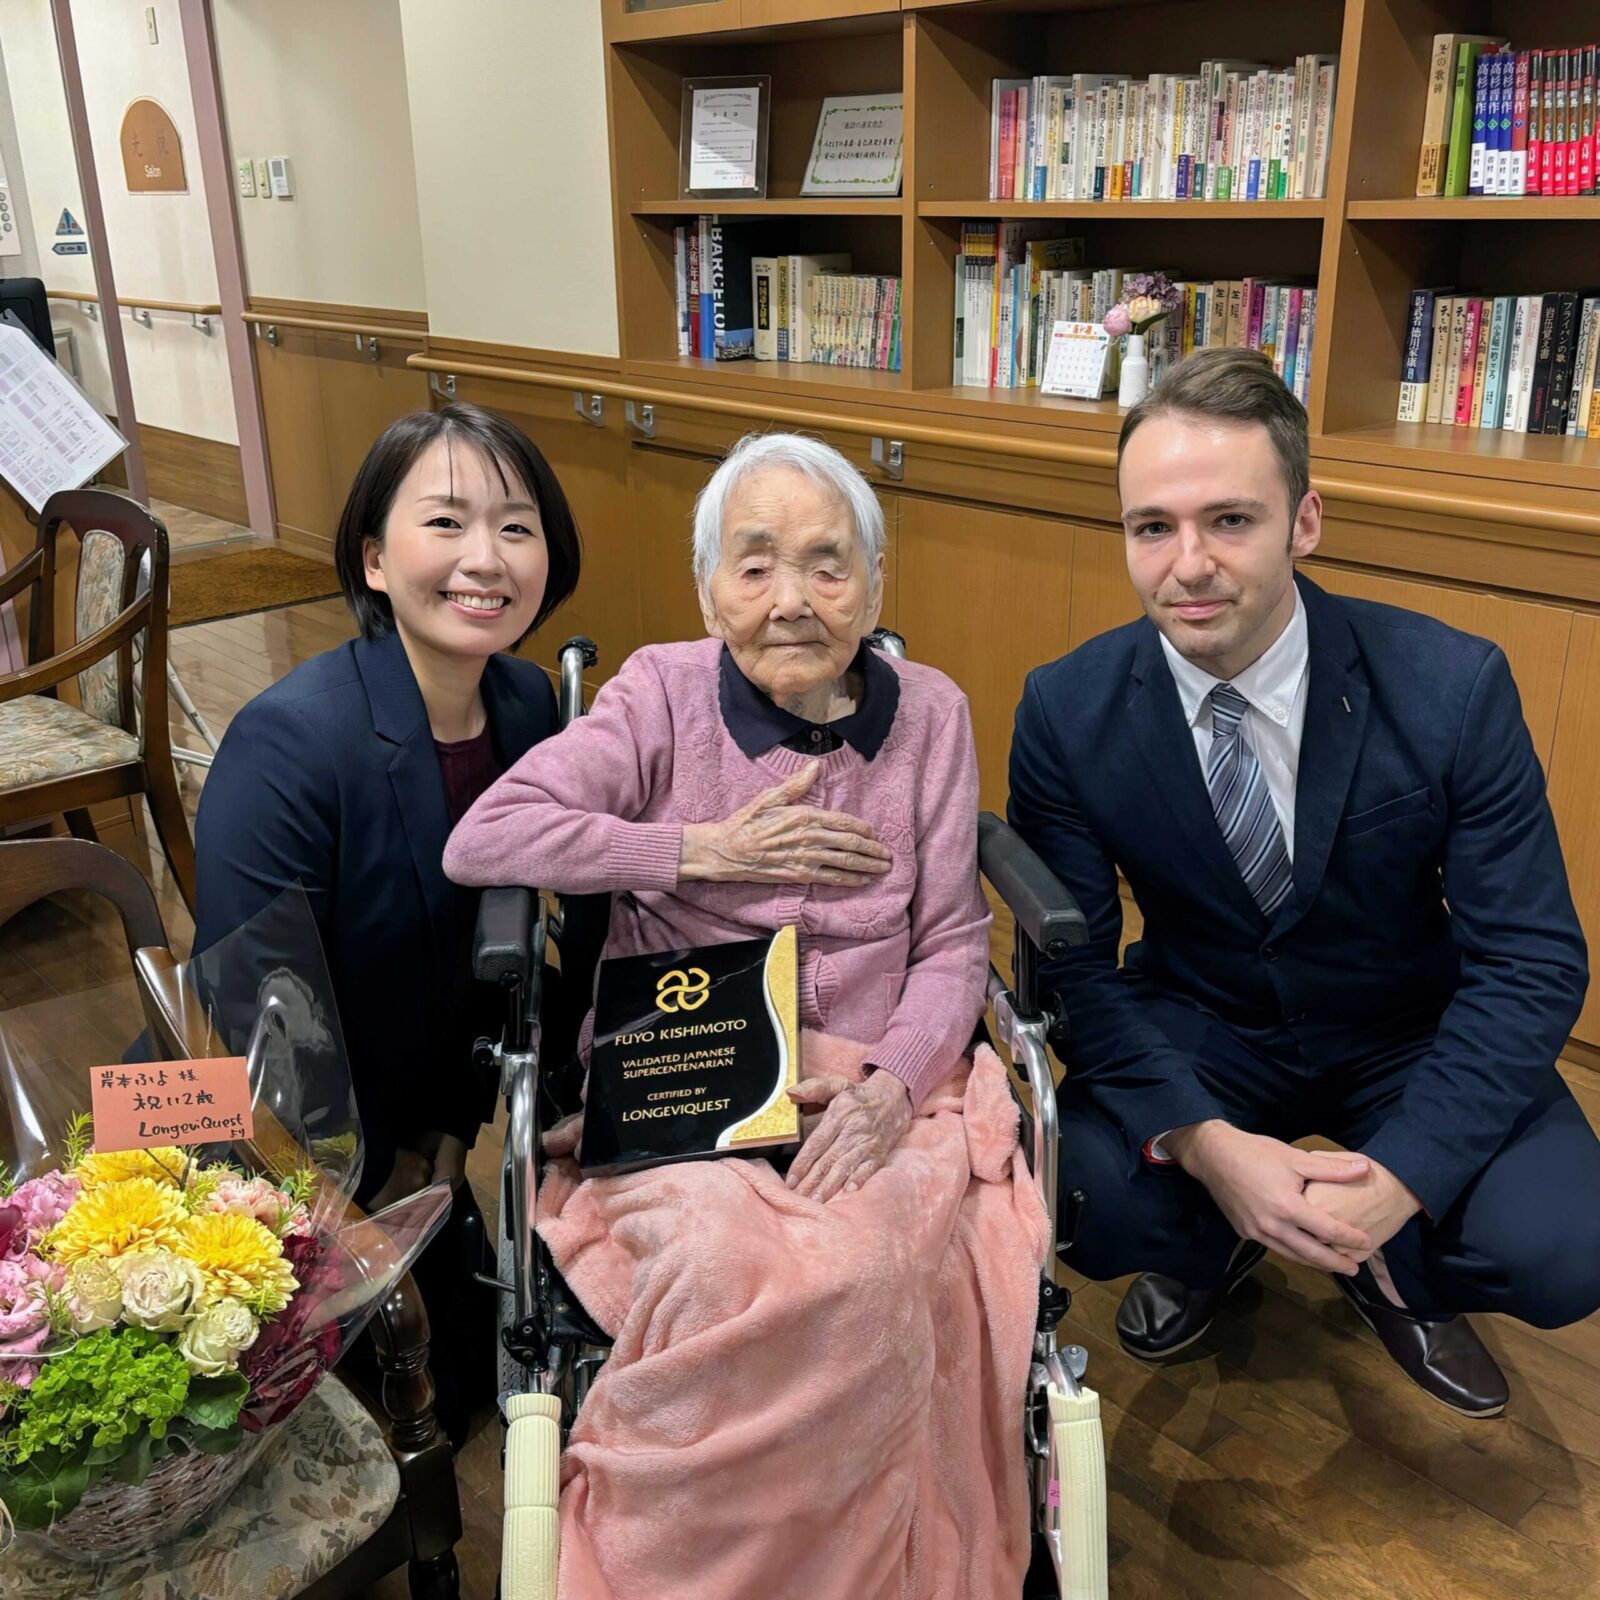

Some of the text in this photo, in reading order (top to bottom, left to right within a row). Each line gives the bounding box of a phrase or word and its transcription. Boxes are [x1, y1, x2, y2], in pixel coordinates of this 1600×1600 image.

[1475, 61, 1489, 115] 高杉晋作
[1488, 61, 1502, 115] 高杉晋作
[1501, 60, 1515, 115] 高杉晋作
[1514, 60, 1528, 114] 高杉晋作
[144, 165, 161, 178] Salon
[1406, 296, 1426, 368] 影武者徳川家康
[1438, 305, 1451, 342] 天と地と
[1452, 305, 1466, 342] 天と地と
[1555, 302, 1572, 364] フライパンの歌
[614, 1019, 747, 1046] FUYO KISHIMOTO
[622, 1046, 736, 1068] VALIDATED JAPANESE
[624, 1058, 734, 1080] SUPERCENTENARIAN
[101, 1069, 199, 1088] 岸本ふよ 様
[647, 1086, 708, 1102] CERTIFIED BY
[622, 1098, 730, 1122] LONGEVIQUEST
[139, 1114, 244, 1139] LongeviQuest
[230, 1128, 245, 1138] より
